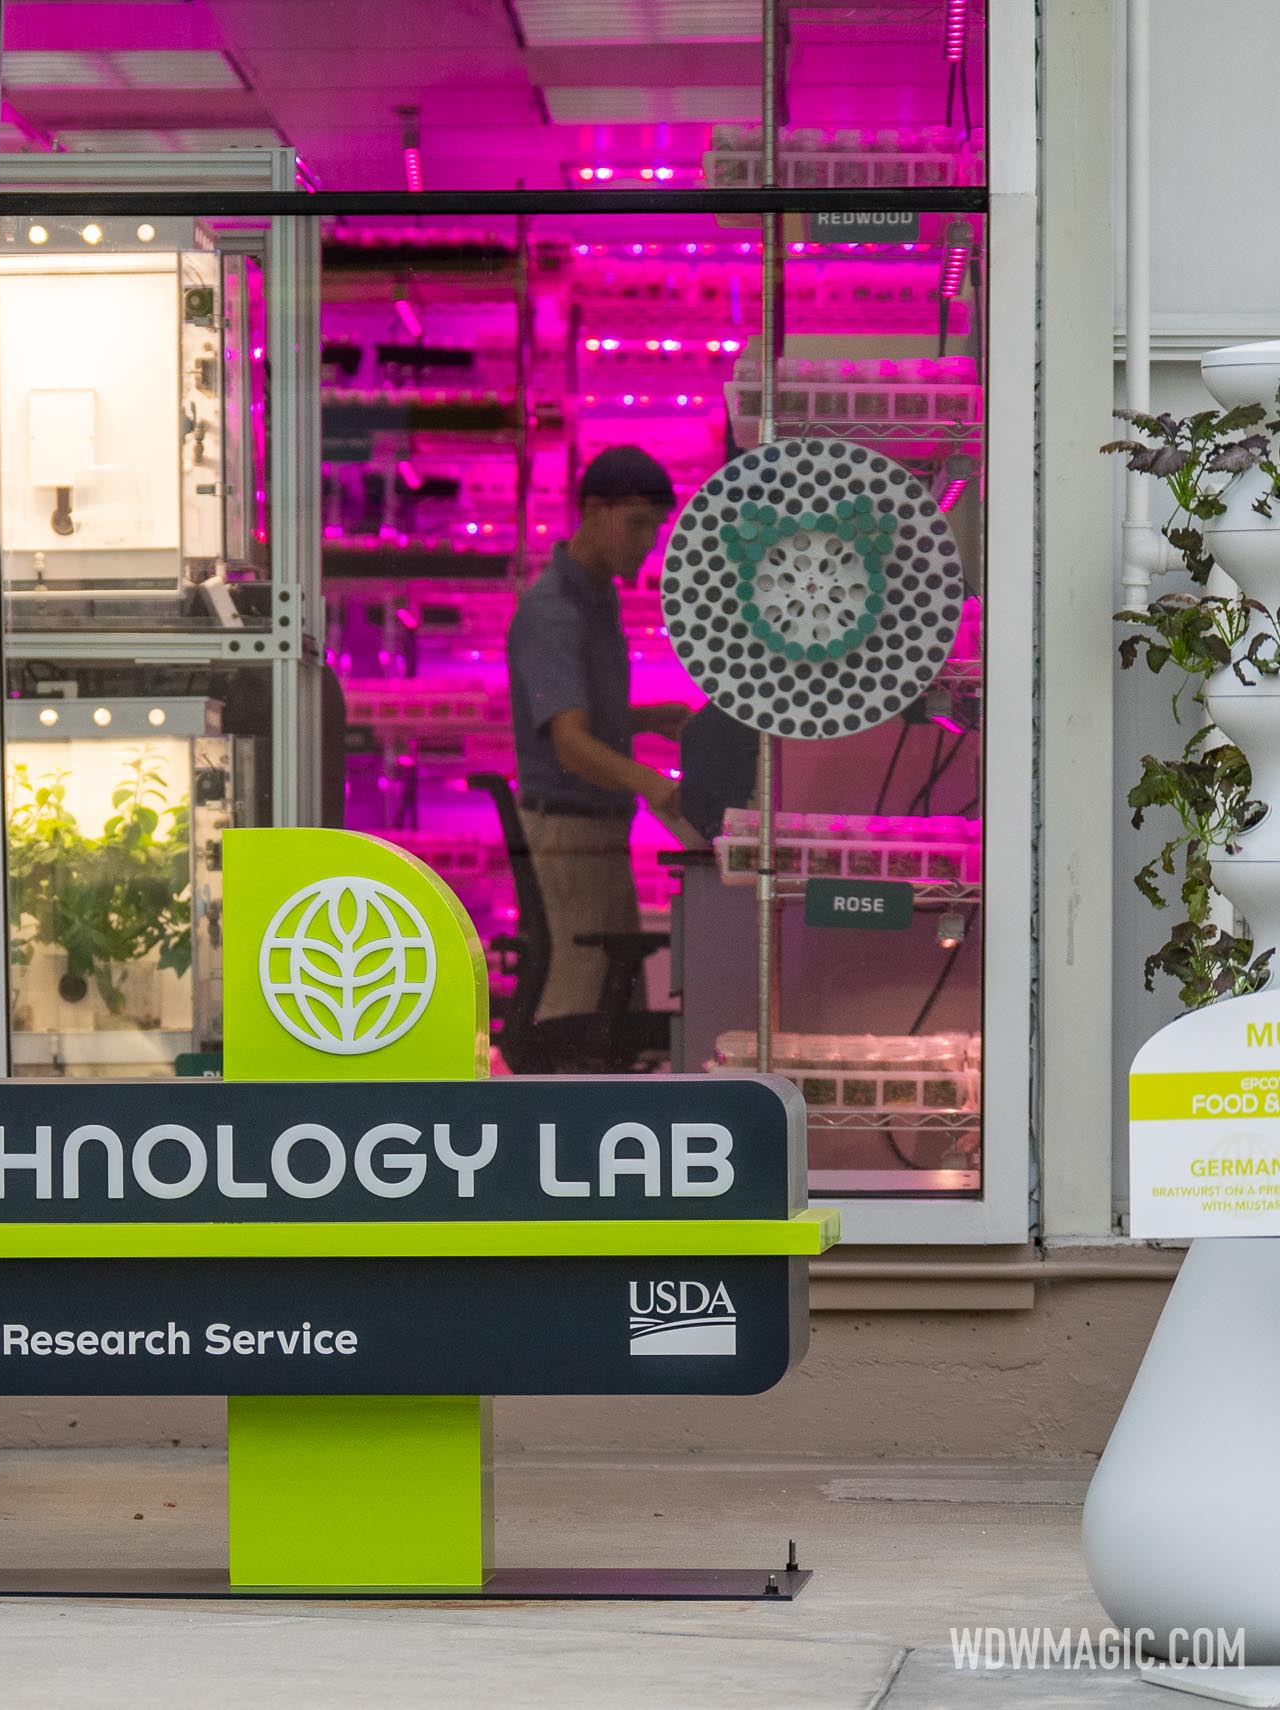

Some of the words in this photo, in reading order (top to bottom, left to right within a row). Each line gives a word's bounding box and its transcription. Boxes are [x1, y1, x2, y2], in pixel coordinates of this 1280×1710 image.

[817, 212, 913, 225] REDWOOD
[833, 896, 885, 912] ROSE
[1247, 1021, 1280, 1048] M
[1241, 1077, 1280, 1091] EPCO
[1192, 1093, 1258, 1115] FOOD
[1264, 1092, 1280, 1113] &
[539, 1121, 735, 1198] LAB
[1152, 1185, 1220, 1197] BRATWURST
[1224, 1185, 1244, 1196] ON
[1247, 1184, 1256, 1195] A
[1202, 1201, 1232, 1211] WITH
[628, 1280, 737, 1315] USDA
[3, 1321, 190, 1356] Research
[204, 1321, 358, 1355] Service
